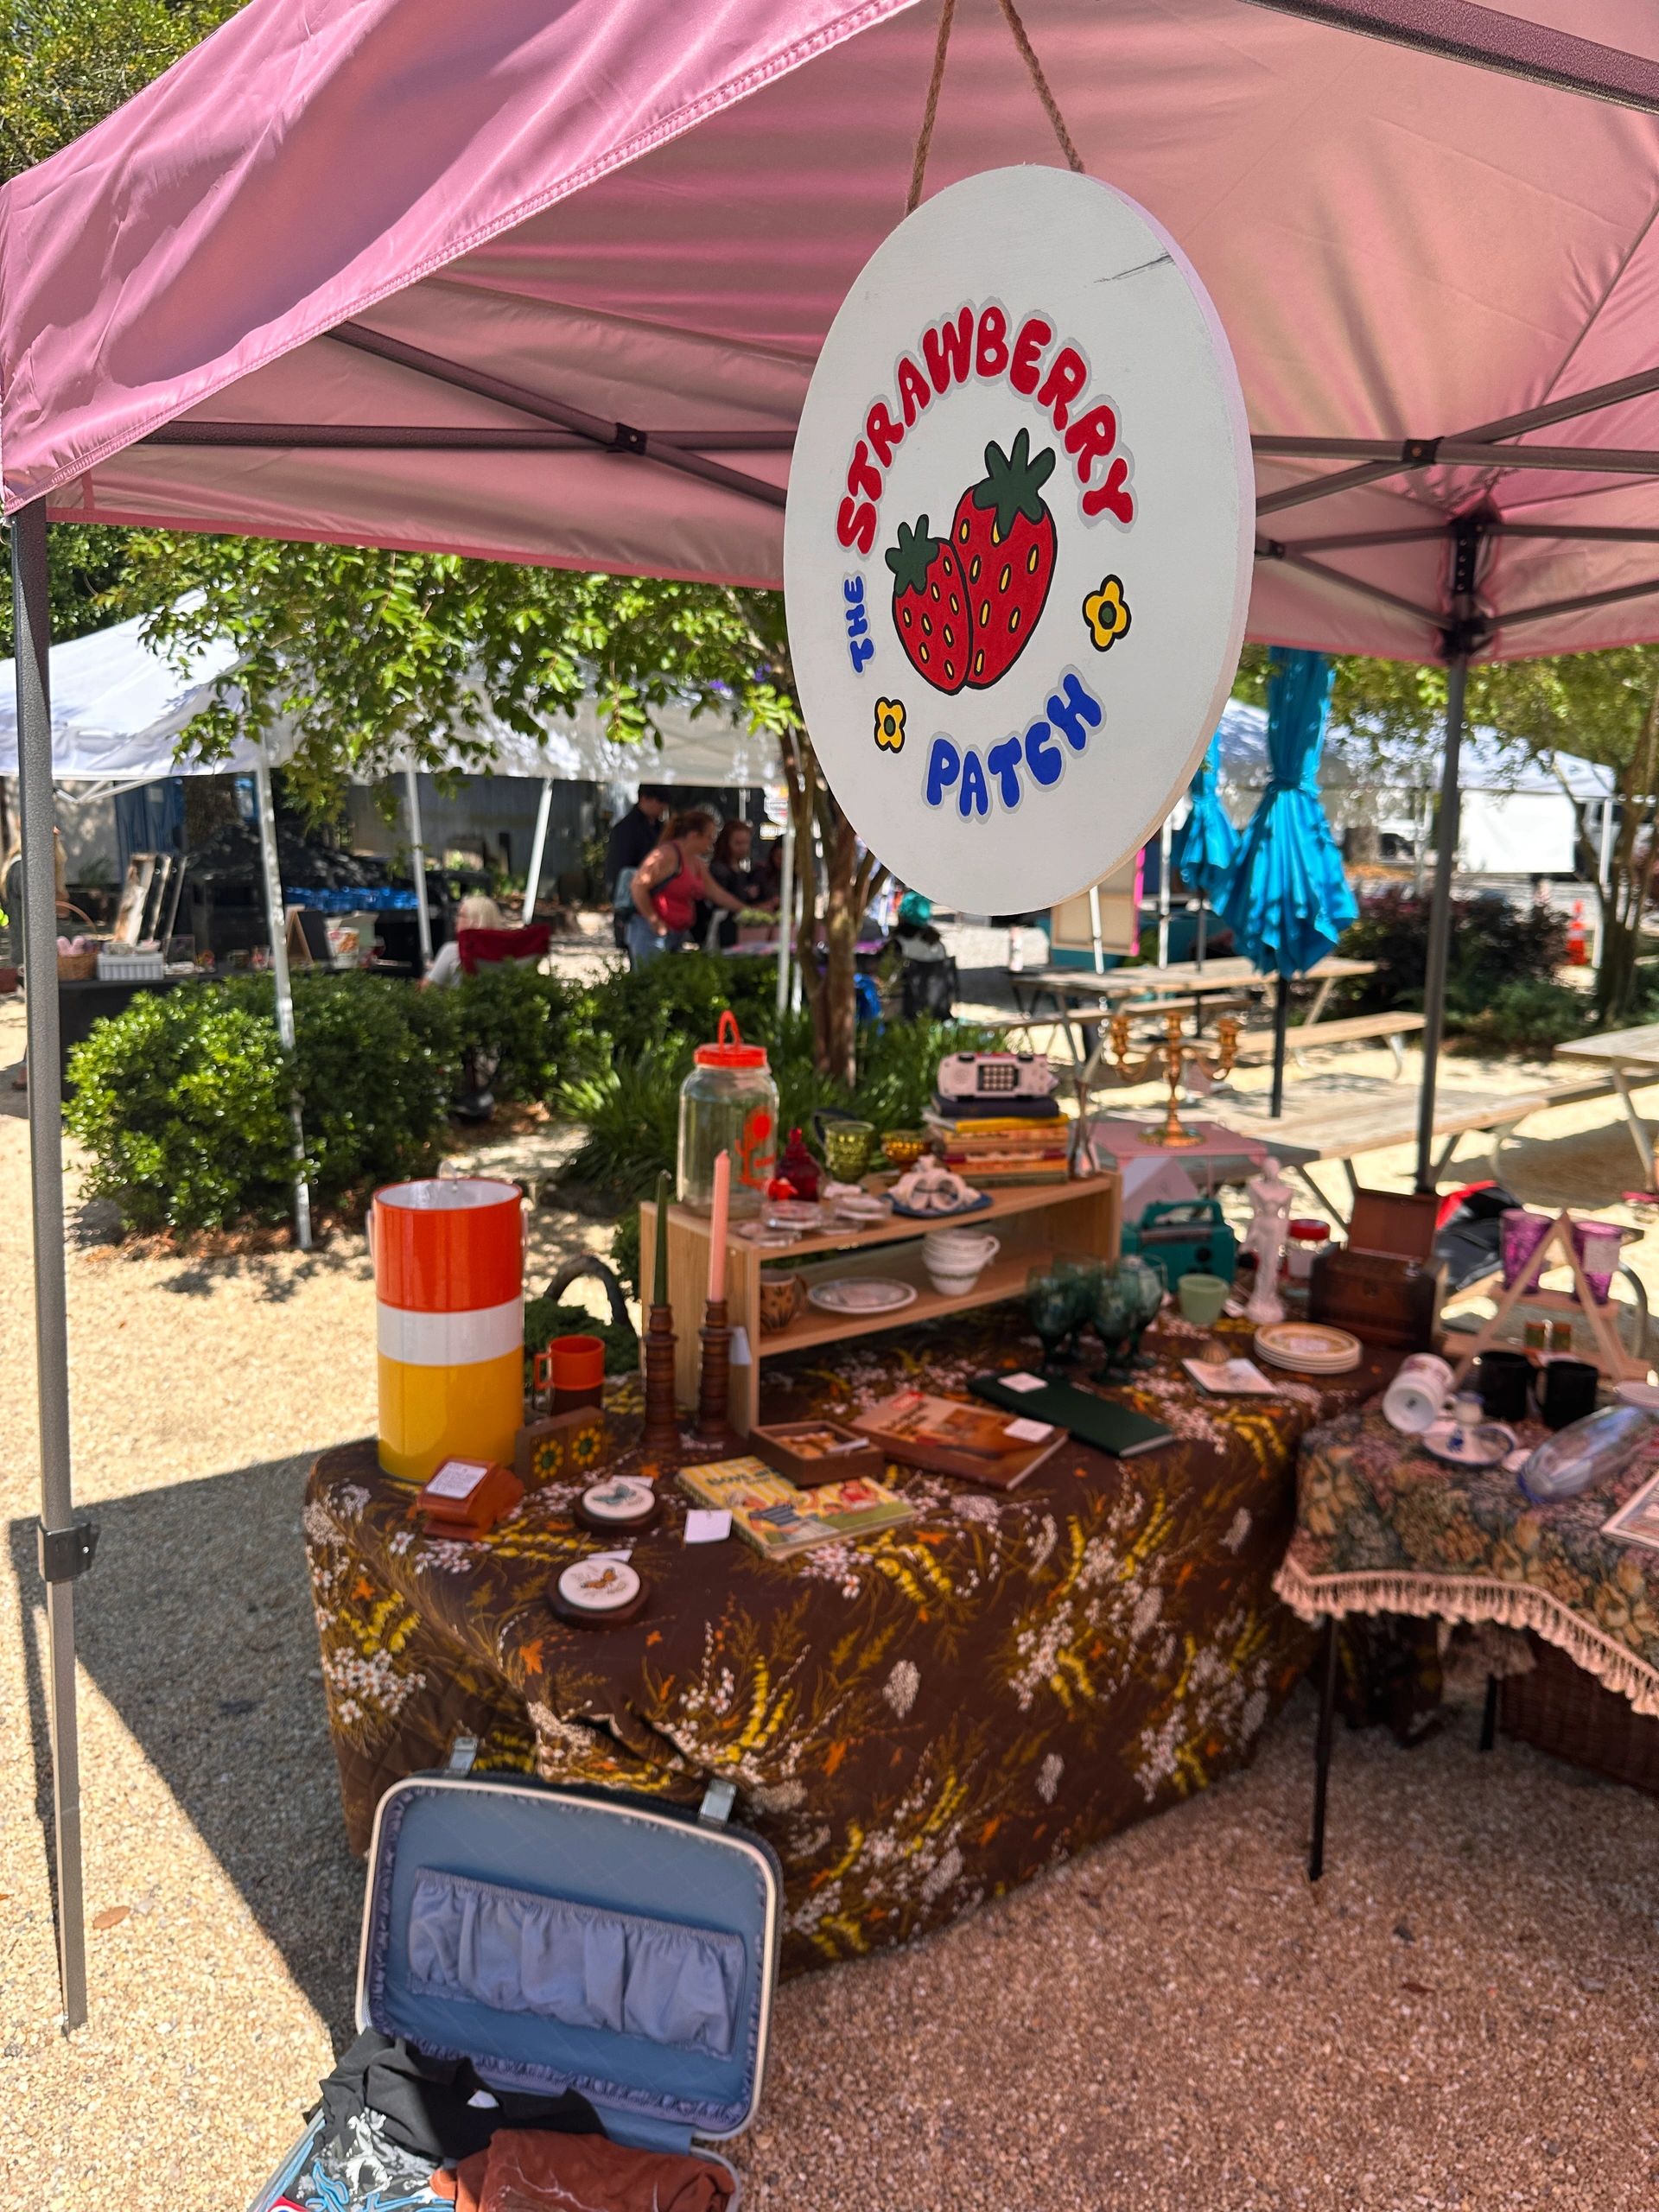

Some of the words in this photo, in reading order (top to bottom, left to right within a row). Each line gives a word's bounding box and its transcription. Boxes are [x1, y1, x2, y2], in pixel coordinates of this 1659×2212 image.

[836, 306, 1134, 555] STRAWBERRY
[843, 575, 874, 673] THE
[926, 673, 1102, 817] PATCH
